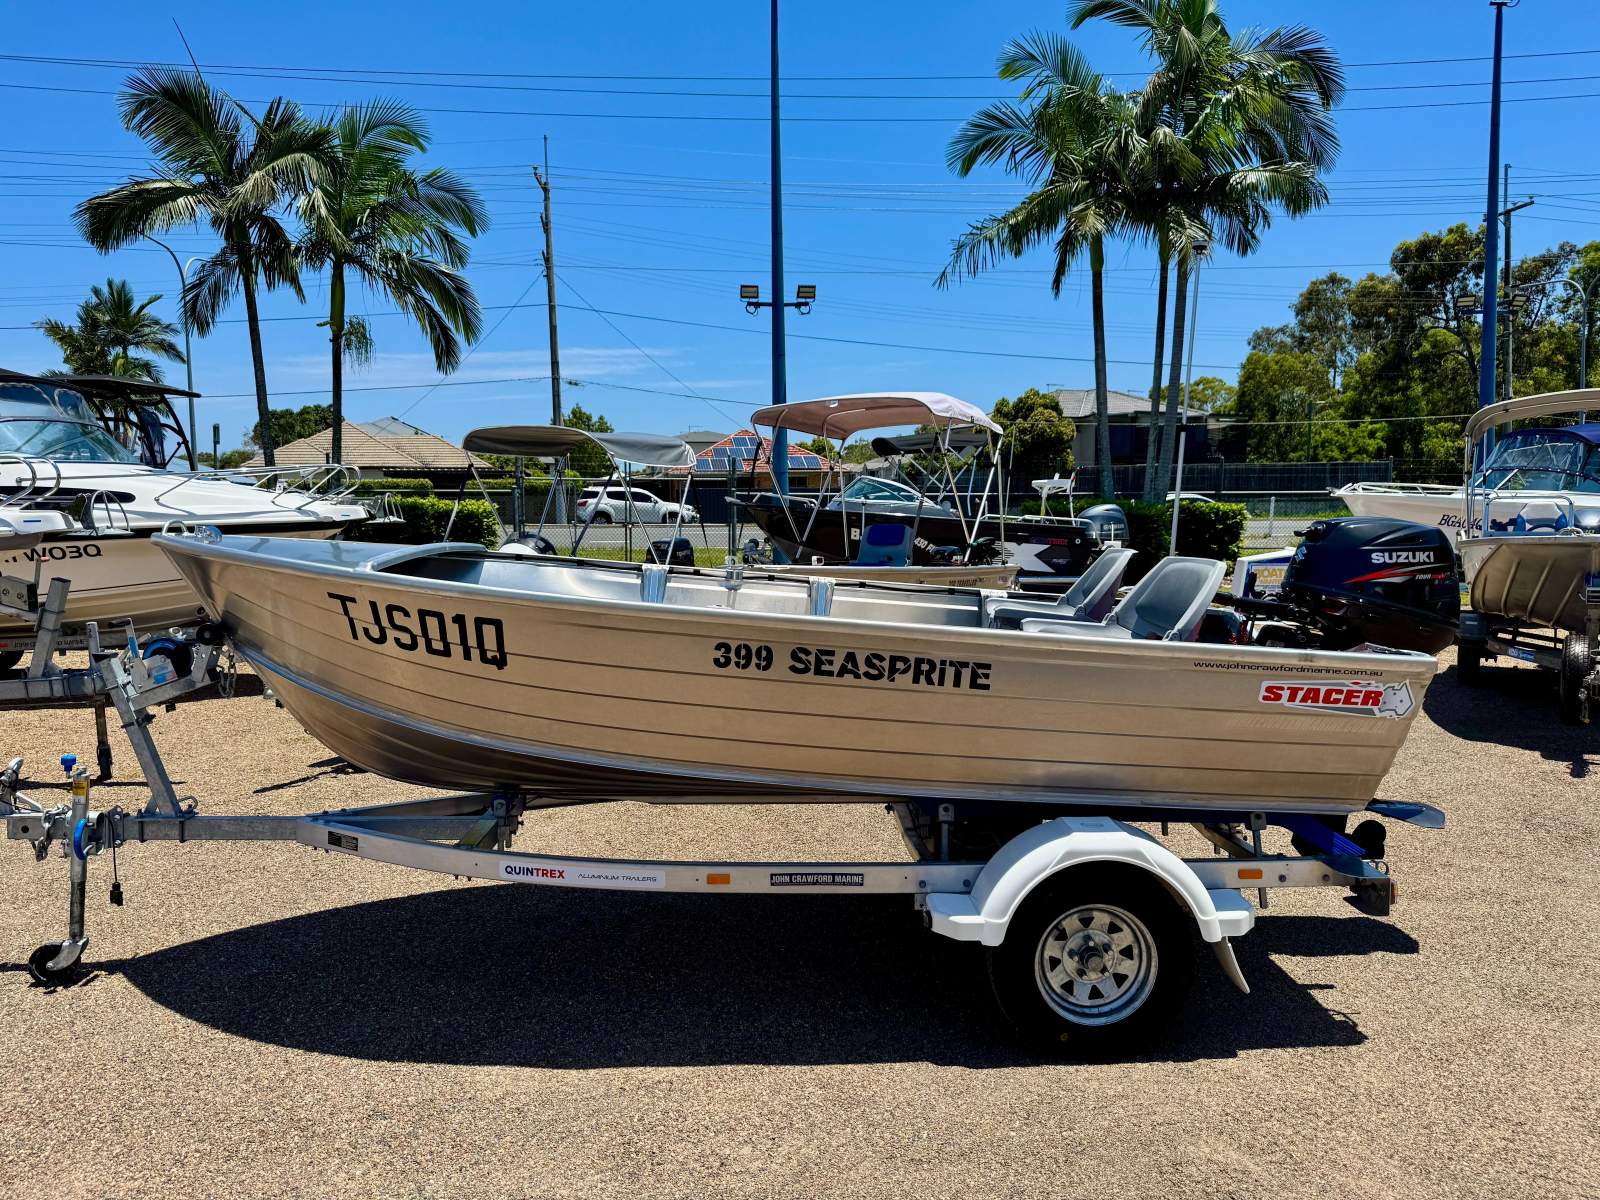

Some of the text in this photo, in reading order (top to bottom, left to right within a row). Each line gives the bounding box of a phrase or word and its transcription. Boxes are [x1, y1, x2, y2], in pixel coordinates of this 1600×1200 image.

[1370, 551, 1435, 564] SUZUKI
[712, 641, 992, 691] 399 SEASPRITE
[1193, 660, 1384, 677] www.johncrawfordmarine.com.au
[1261, 684, 1385, 708] STACER
[504, 865, 657, 883] QUINTREX ALUMINIUM TRAILERS
[771, 874, 864, 884] JOHN CRAWFORD MARINE
